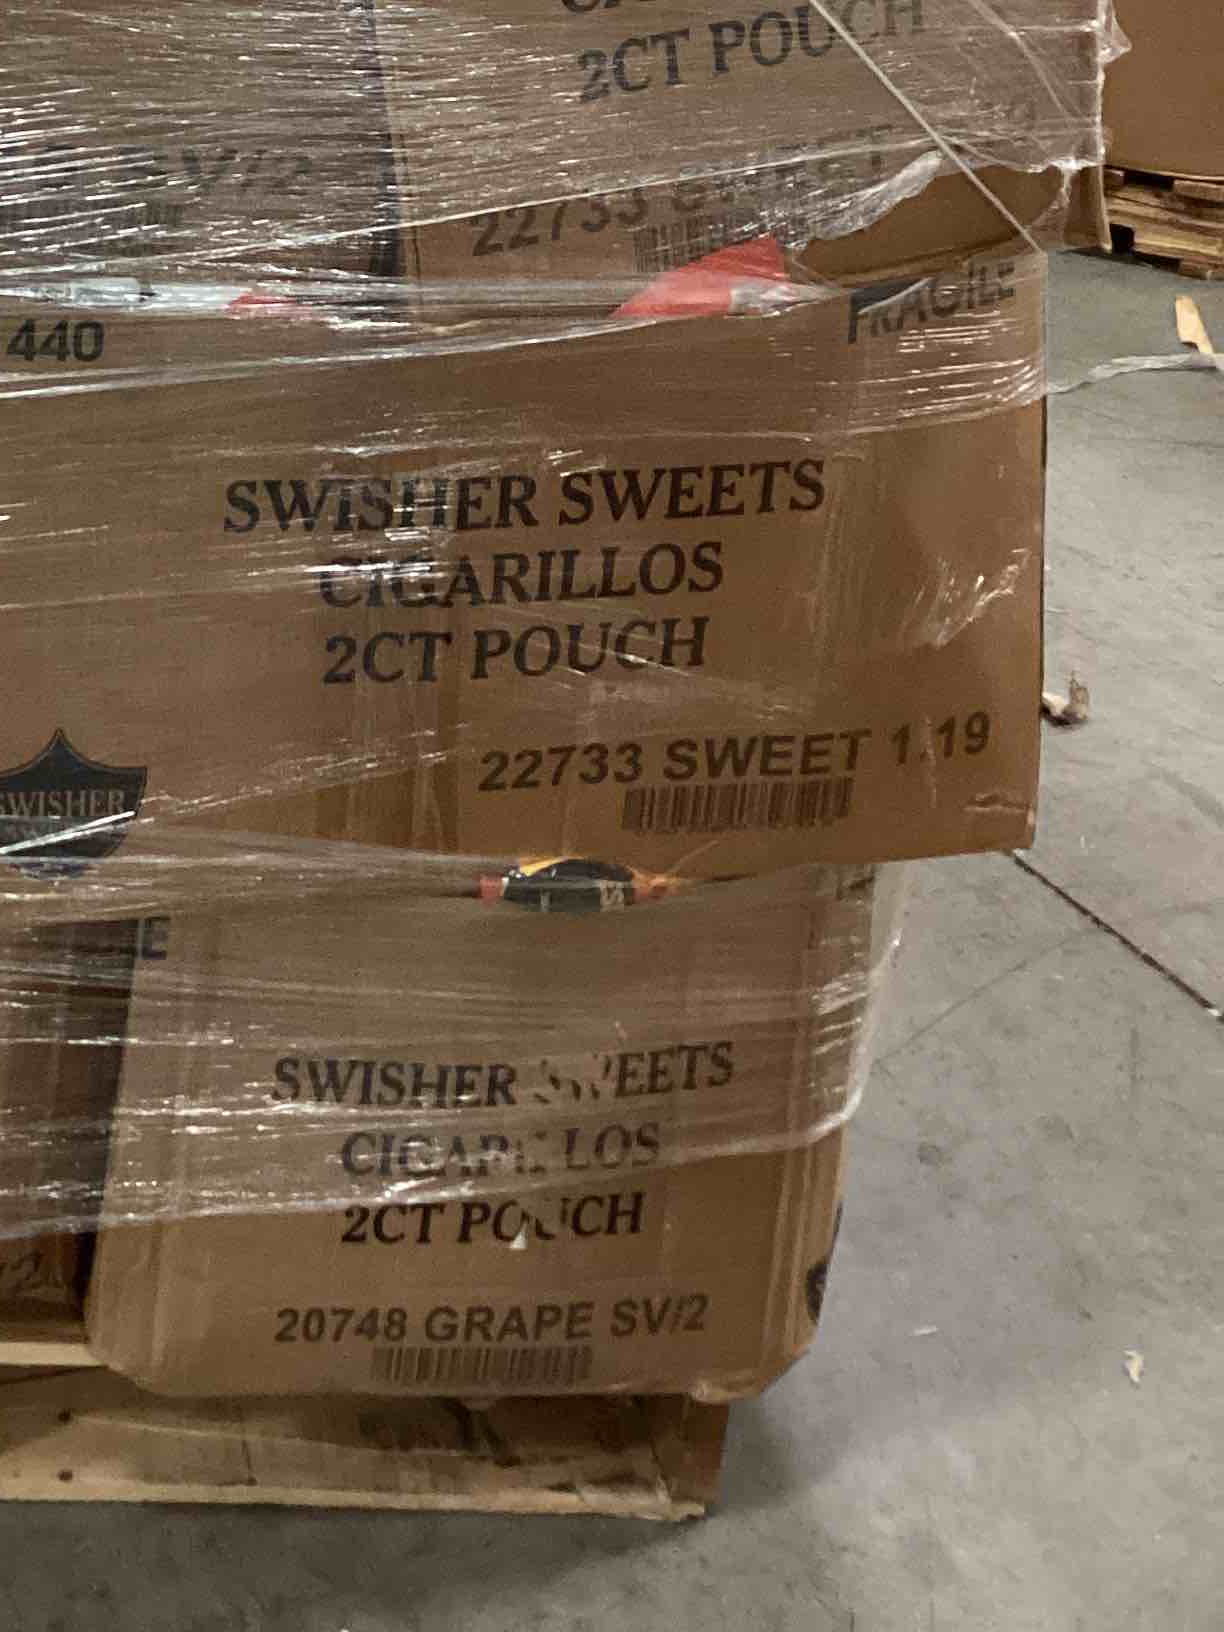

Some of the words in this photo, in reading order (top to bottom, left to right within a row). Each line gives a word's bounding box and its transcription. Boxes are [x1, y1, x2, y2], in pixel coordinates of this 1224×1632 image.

[579, 28, 690, 104] 2CT
[848, 258, 1016, 345] FRAGILE
[223, 472, 541, 533] SWISHER
[558, 459, 828, 528] SWEETS
[318, 540, 725, 610] CIGARILLOS
[323, 630, 455, 685] 2CT
[469, 614, 711, 681] POUCH
[477, 742, 645, 793] 22733
[663, 727, 872, 781] SWEET
[270, 1057, 519, 1108] SWISHER
[341, 1202, 446, 1245] 2CT
[273, 1305, 408, 1343] 20748
[423, 1297, 596, 1344] GRAPE
[610, 1292, 710, 1337] SV/2
